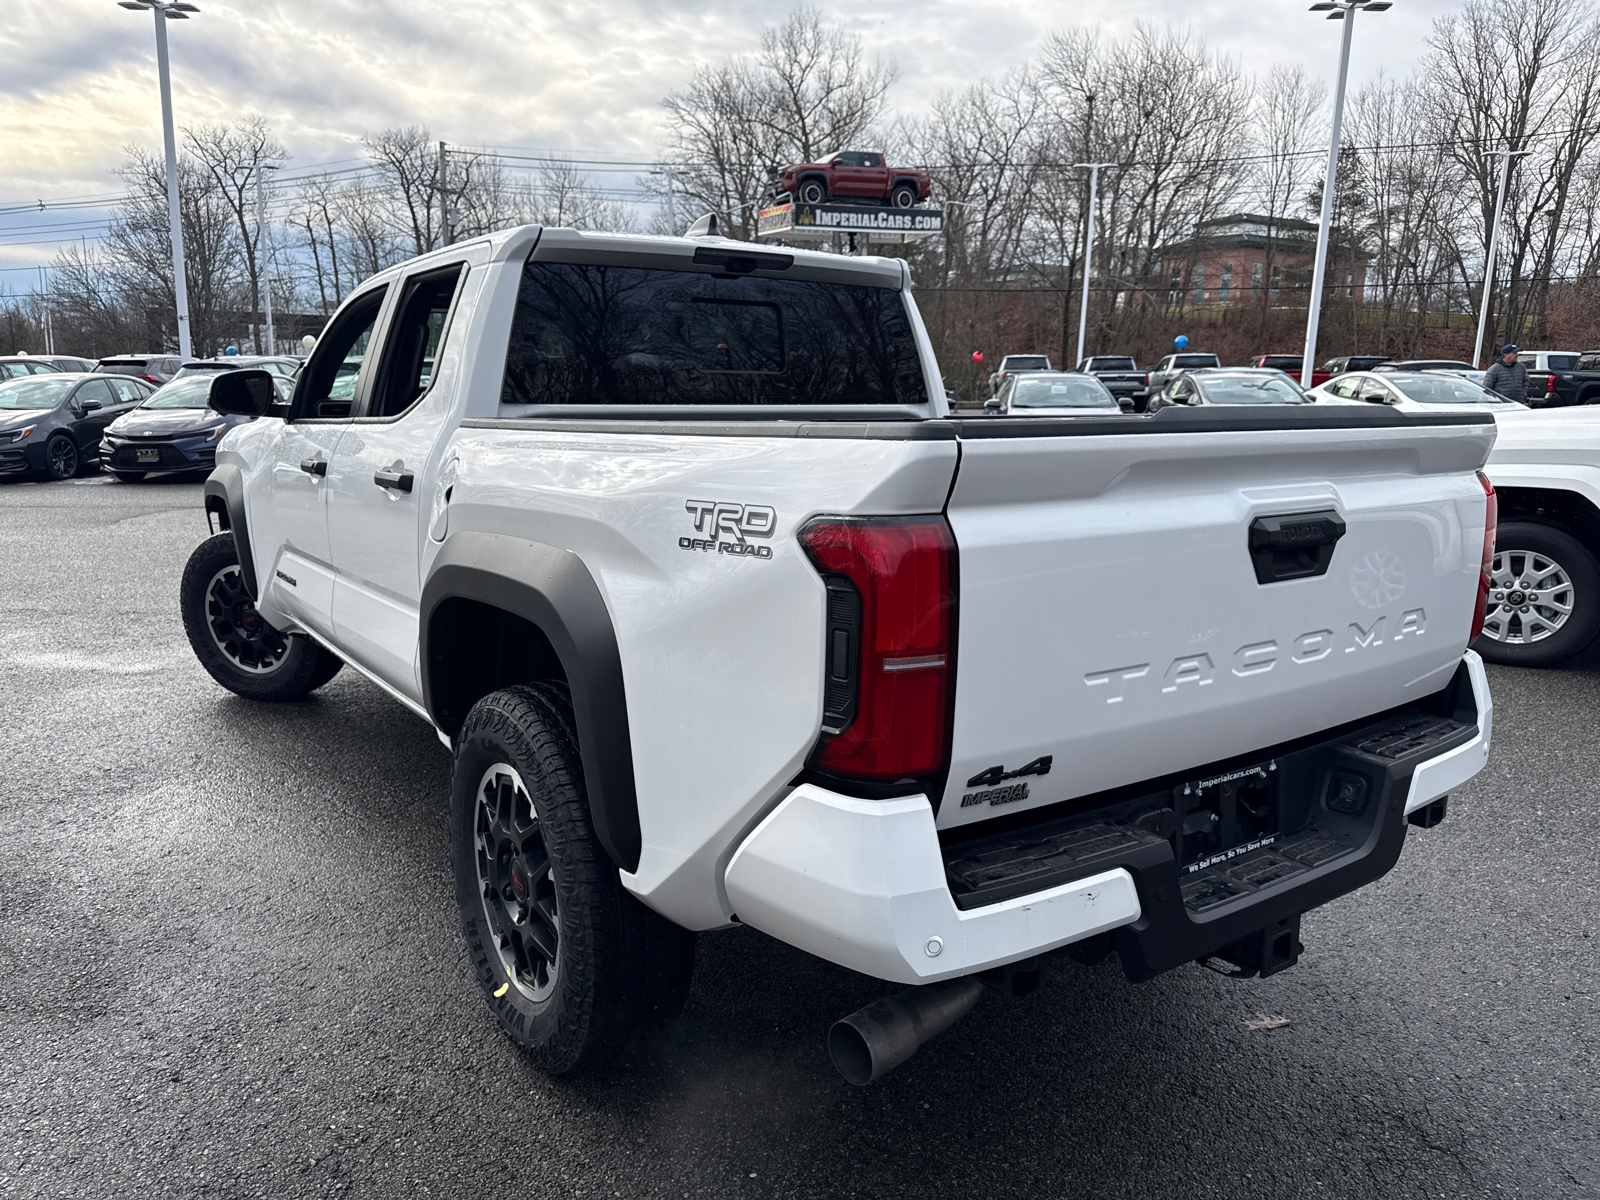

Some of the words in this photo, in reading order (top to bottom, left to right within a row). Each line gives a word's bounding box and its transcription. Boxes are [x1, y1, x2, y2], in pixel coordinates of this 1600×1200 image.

[685, 499, 777, 545] TRD
[1282, 523, 1325, 540] TOYOTA
[679, 537, 717, 553] OFF
[718, 541, 773, 560] ROAD
[1084, 607, 1427, 704] TACOMA
[1198, 766, 1261, 788] Imperialcars.com
[960, 782, 1030, 807] IMPERIAL
[1189, 865, 1199, 873] We
[1199, 858, 1210, 870] Sell
[1227, 850, 1235, 859] So
[1236, 847, 1247, 856] You
[1247, 842, 1260, 851] Save
[1261, 837, 1275, 846] More
